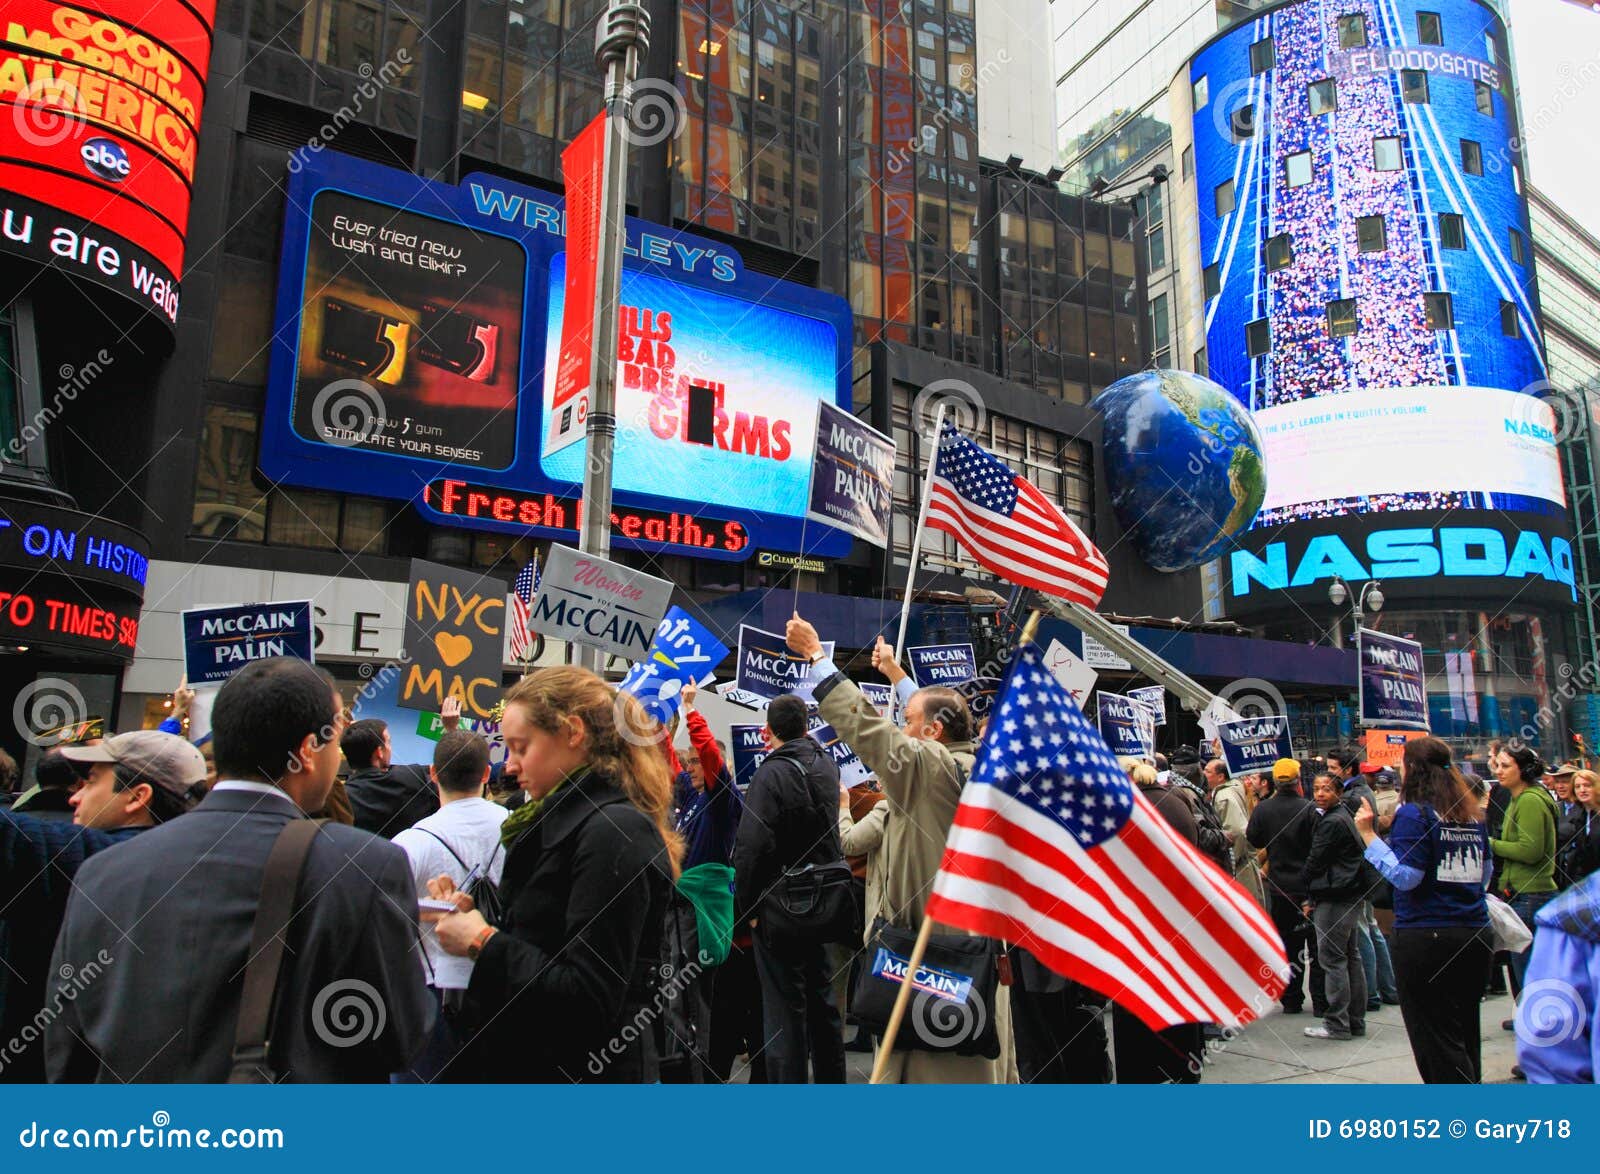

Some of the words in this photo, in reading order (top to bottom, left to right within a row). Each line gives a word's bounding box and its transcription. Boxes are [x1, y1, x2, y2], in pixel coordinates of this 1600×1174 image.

[52, 7, 181, 84] GOOD
[6, 22, 196, 126] MORNING
[1351, 51, 1500, 89] FLOODGATES
[0, 57, 194, 184] AMERICA
[80, 143, 131, 176] abc
[331, 232, 374, 254] Lush
[380, 246, 414, 265] and
[333, 215, 374, 237] Ever
[380, 226, 417, 248] tried
[421, 239, 462, 259] new
[50, 226, 121, 276] are
[131, 258, 179, 324] watc
[617, 334, 676, 371] BAD
[368, 414, 399, 429] new
[415, 424, 443, 436] gum
[648, 397, 793, 462] GRMS
[1299, 413, 1332, 426] LEADER
[1334, 412, 1344, 421] IN
[1392, 404, 1428, 415] VOLUME
[323, 426, 396, 448] STIMULATE
[400, 437, 431, 453] YOUR
[442, 479, 564, 529] Fresh
[835, 468, 879, 510] PALIN
[24, 524, 76, 561] ON
[85, 536, 149, 587] HISTOR
[1230, 527, 1578, 603] NASDAQ
[574, 559, 645, 601] Women
[45, 598, 115, 642] TIMES
[201, 611, 295, 636] McCAIN
[416, 580, 504, 636] NYC
[533, 593, 657, 653] McCAIN
[215, 640, 284, 663] PALIN
[920, 648, 968, 664] McCAIN
[1370, 645, 1420, 673] McCAIN
[404, 664, 497, 718] MAC
[930, 665, 967, 679] PALIN
[1382, 679, 1423, 703] PALIN
[1229, 723, 1281, 741] McCAIN
[1241, 743, 1278, 759] PALIN
[884, 957, 961, 994] McCAIN
